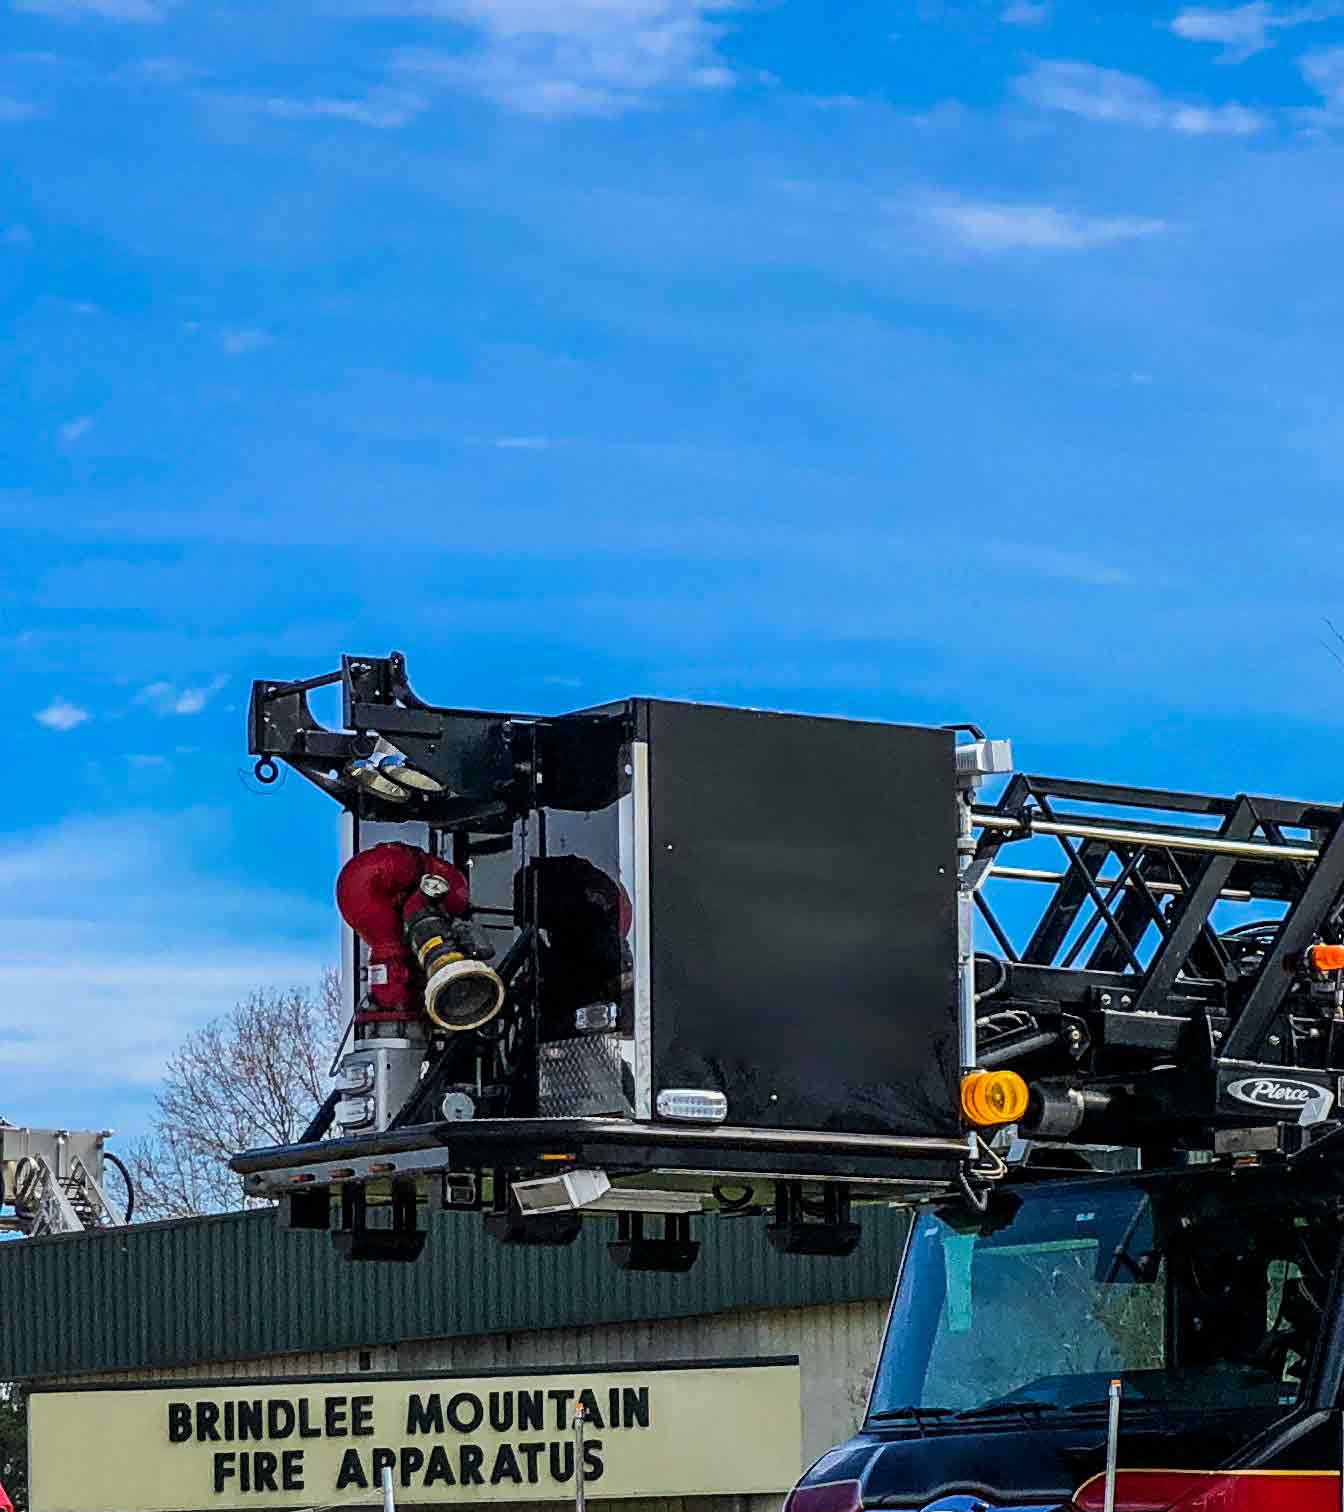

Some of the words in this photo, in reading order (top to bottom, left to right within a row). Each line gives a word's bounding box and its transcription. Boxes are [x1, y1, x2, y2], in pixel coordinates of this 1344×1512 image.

[1250, 1080, 1310, 1101] Pierce
[168, 1396, 374, 1443] BRINDLEE
[407, 1387, 650, 1434] MOUNTAIN
[213, 1450, 305, 1493] FIRE
[336, 1439, 604, 1489] APPARATUS
